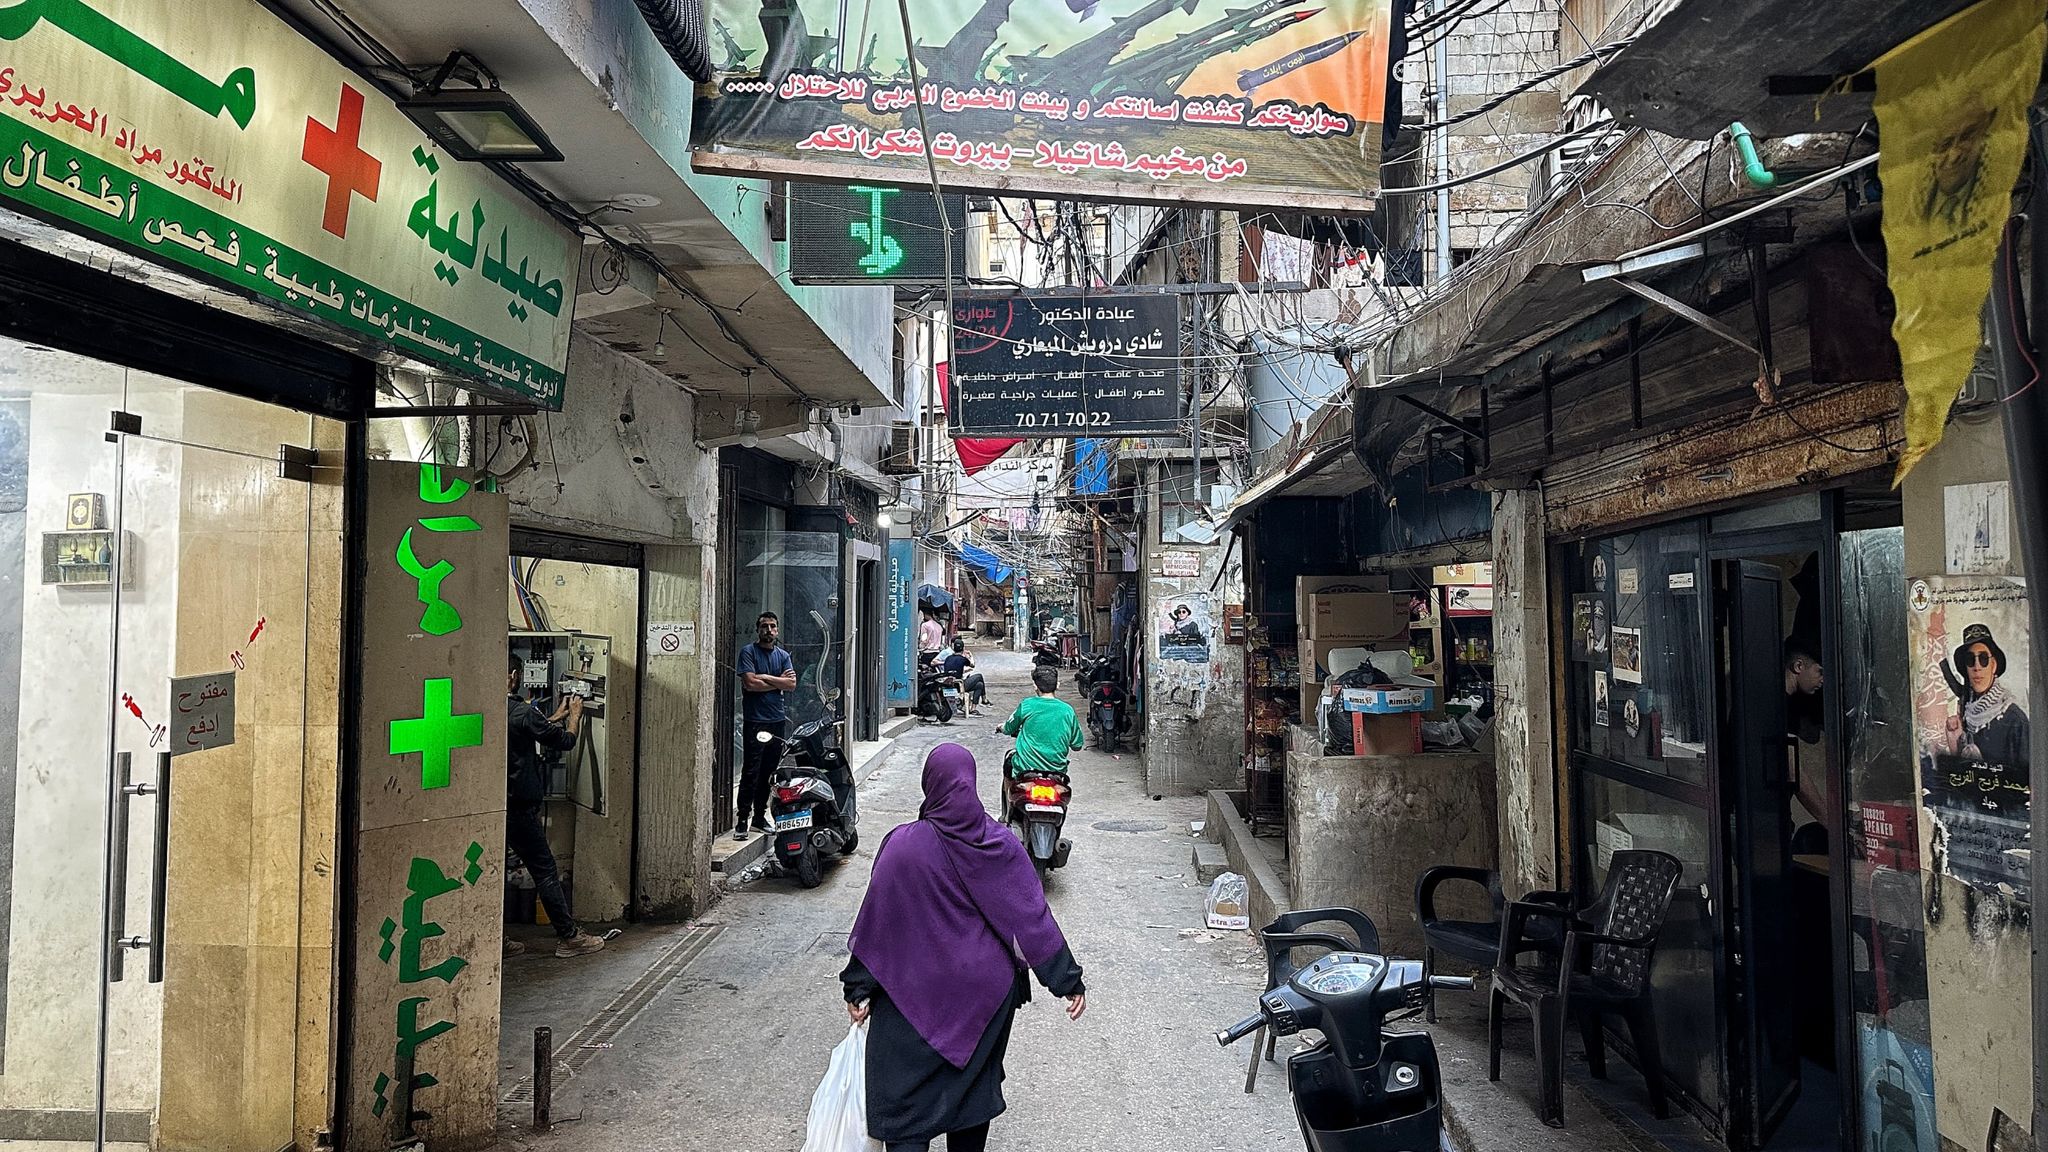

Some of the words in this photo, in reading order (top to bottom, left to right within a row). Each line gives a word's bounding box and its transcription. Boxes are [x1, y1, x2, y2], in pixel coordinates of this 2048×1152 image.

[780, 73, 867, 100] للاحتلال
[941, 84, 1016, 113] الخضوع
[1019, 90, 1069, 121] بينت
[1073, 99, 1090, 119] و
[1094, 96, 1179, 121] اصالتكم
[1183, 98, 1246, 125] كشفت
[1248, 103, 1349, 133] صواريخكم
[114, 127, 162, 166] مراد
[932, 131, 1013, 170] بيروت
[1034, 141, 1127, 174] شاتيلا
[1131, 145, 1206, 178] مخيم
[1206, 152, 1248, 181] من
[1, 140, 140, 225] أطفال
[164, 156, 243, 205] الدكتور
[142, 217, 241, 268] فحص
[406, 144, 564, 323] صيدلية
[263, 245, 345, 311] طبية
[350, 288, 461, 357] مستلزمات
[1039, 307, 1092, 326] الدكتور
[1095, 306, 1136, 324] عيادة
[1012, 334, 1066, 360] الميعاري
[1070, 330, 1122, 358] درويش
[1126, 328, 1164, 358] شادي
[473, 340, 522, 384] طبية
[1103, 369, 1132, 379] عامة
[524, 363, 560, 401] أدوية
[962, 371, 996, 383] داخلية
[962, 389, 996, 403] صغيرة
[1000, 390, 1036, 401] جراحية
[1041, 389, 1078, 400] عمليات
[1094, 385, 1127, 399] أطفال
[1131, 388, 1165, 400] طهور
[1015, 412, 1036, 427] 70
[1040, 412, 1060, 427] 71
[1065, 412, 1086, 427] 70
[1090, 411, 1112, 427] 22
[993, 459, 1022, 472] النداء
[1025, 459, 1053, 473] مركز
[888, 557, 900, 593] صيدلية
[650, 624, 672, 633] التدخين
[673, 625, 693, 633] ممنوع
[178, 681, 228, 713] مفتوح
[1388, 698, 1411, 706] Rimas
[186, 713, 219, 745] إدفع
[1863, 819, 1894, 837] SPEAKER
